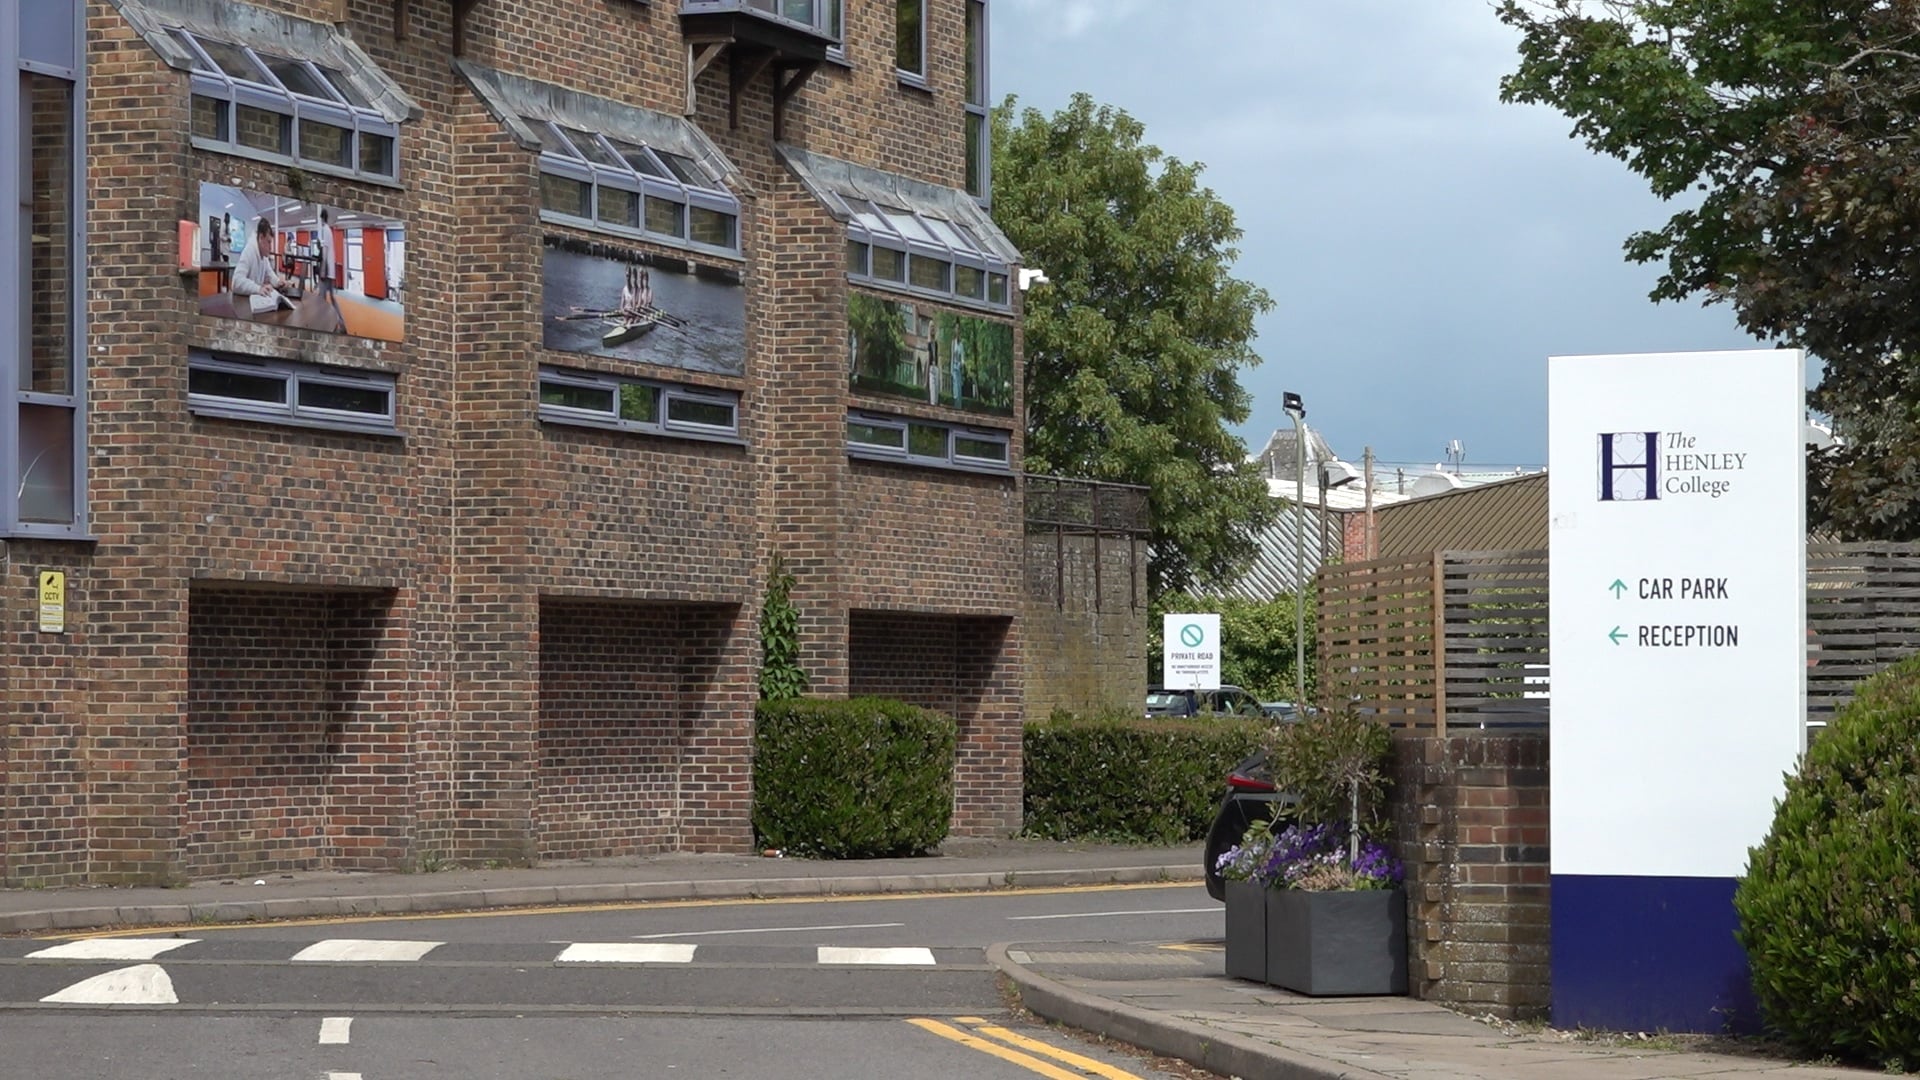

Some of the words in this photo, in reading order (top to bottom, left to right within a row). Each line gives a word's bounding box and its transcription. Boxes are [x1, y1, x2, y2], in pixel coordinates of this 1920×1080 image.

[1667, 431, 1697, 449] The
[1665, 453, 1748, 471] HENLEY
[1665, 475, 1731, 498] College
[44, 592, 60, 600] CCTV
[1638, 577, 1674, 600] CAR
[1681, 577, 1729, 600] PARK
[1638, 624, 1738, 648] RECEPTION
[1171, 652, 1195, 660] PRIVATE
[1197, 652, 1213, 660] ROAD
